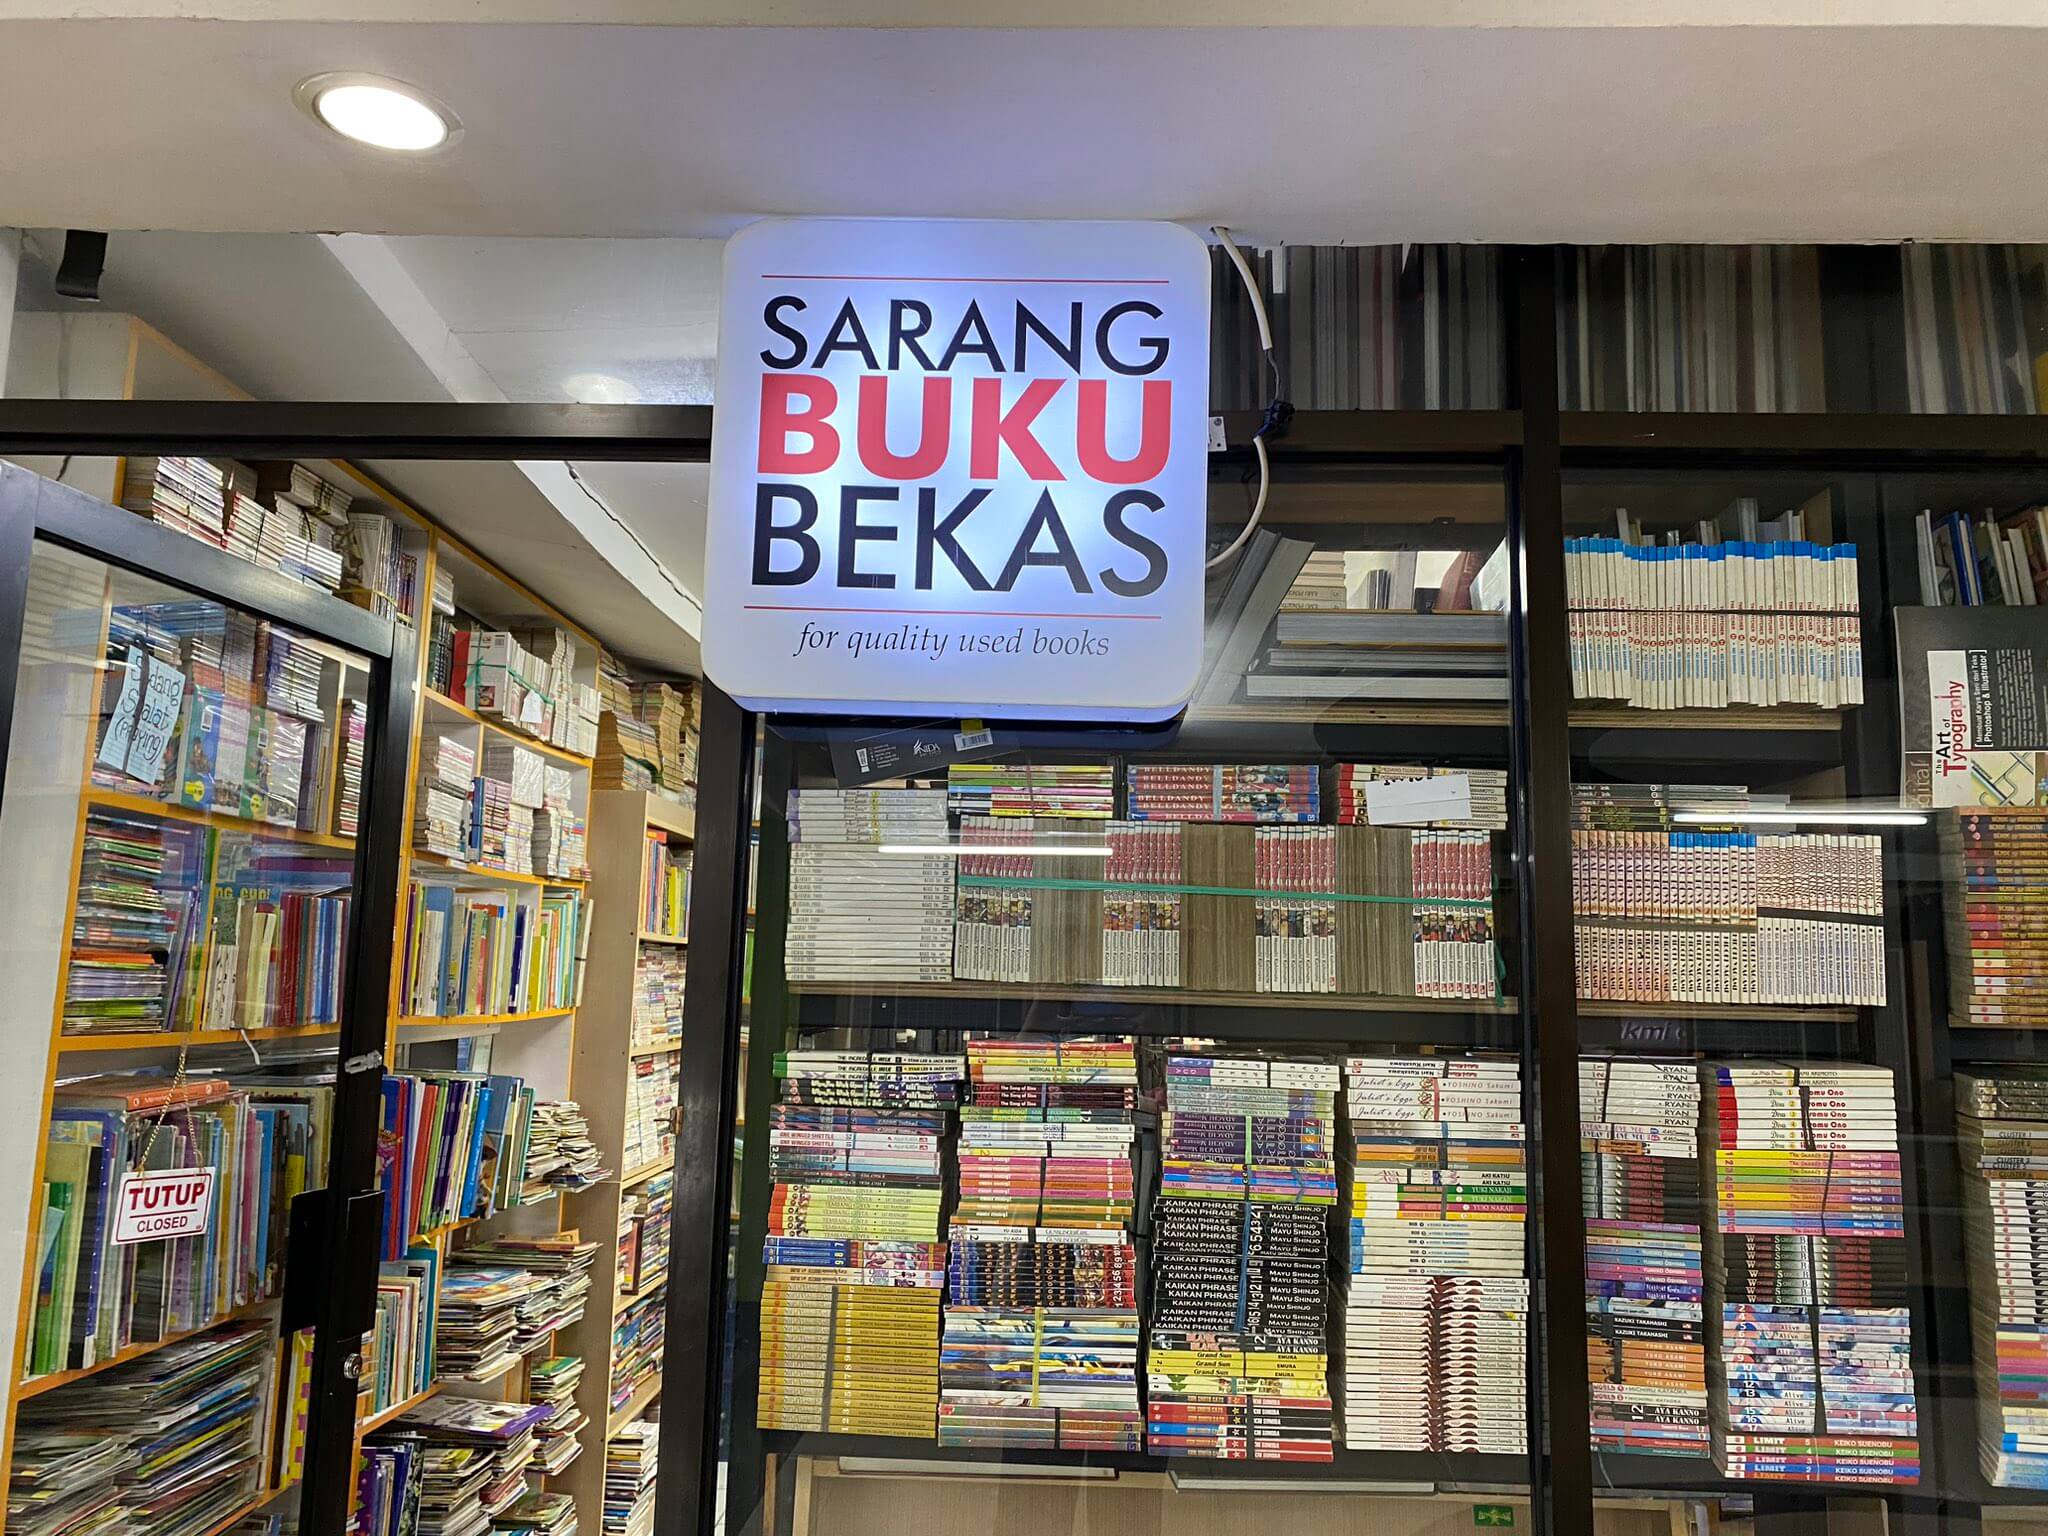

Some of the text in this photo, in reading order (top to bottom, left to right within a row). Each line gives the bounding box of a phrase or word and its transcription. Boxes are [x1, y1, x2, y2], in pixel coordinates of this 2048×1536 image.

[760, 296, 1170, 376] SARANG
[757, 373, 1172, 485] BUKU
[752, 483, 1169, 598] BEKAS
[794, 621, 1110, 661] for quality used books
[1980, 655, 1991, 692] Illustrator
[131, 656, 181, 706] Sdang
[1943, 718, 1950, 729] of
[1982, 700, 1993, 743] Photoshop
[1934, 680, 1968, 777] Typography
[1936, 731, 1951, 758] Art
[128, 1182, 205, 1211] TUTUP
[1202, 1202, 1239, 1210] PHRASE
[1199, 1209, 1237, 1217] PHRASE
[137, 1216, 188, 1233] CLOSED
[1164, 1222, 1238, 1233] KAIKAN PHRASE
[1200, 1232, 1238, 1240] PHRASE
[1271, 1227, 1291, 1235] MAYU
[1168, 1272, 1202, 1280] KAIKAN
[1165, 1281, 1238, 1292] KAIKAN PHRASE
[1614, 1317, 1667, 1327] KAZUKI TAKAHASHI
[1636, 1331, 1668, 1339] TAKAHASHI
[1631, 1404, 1700, 1416] 2 AYA KANNO
[1654, 1416, 1671, 1424] AYA
[1672, 1417, 1700, 1425] KANNO
[1858, 1440, 1893, 1448] SUENOBU
